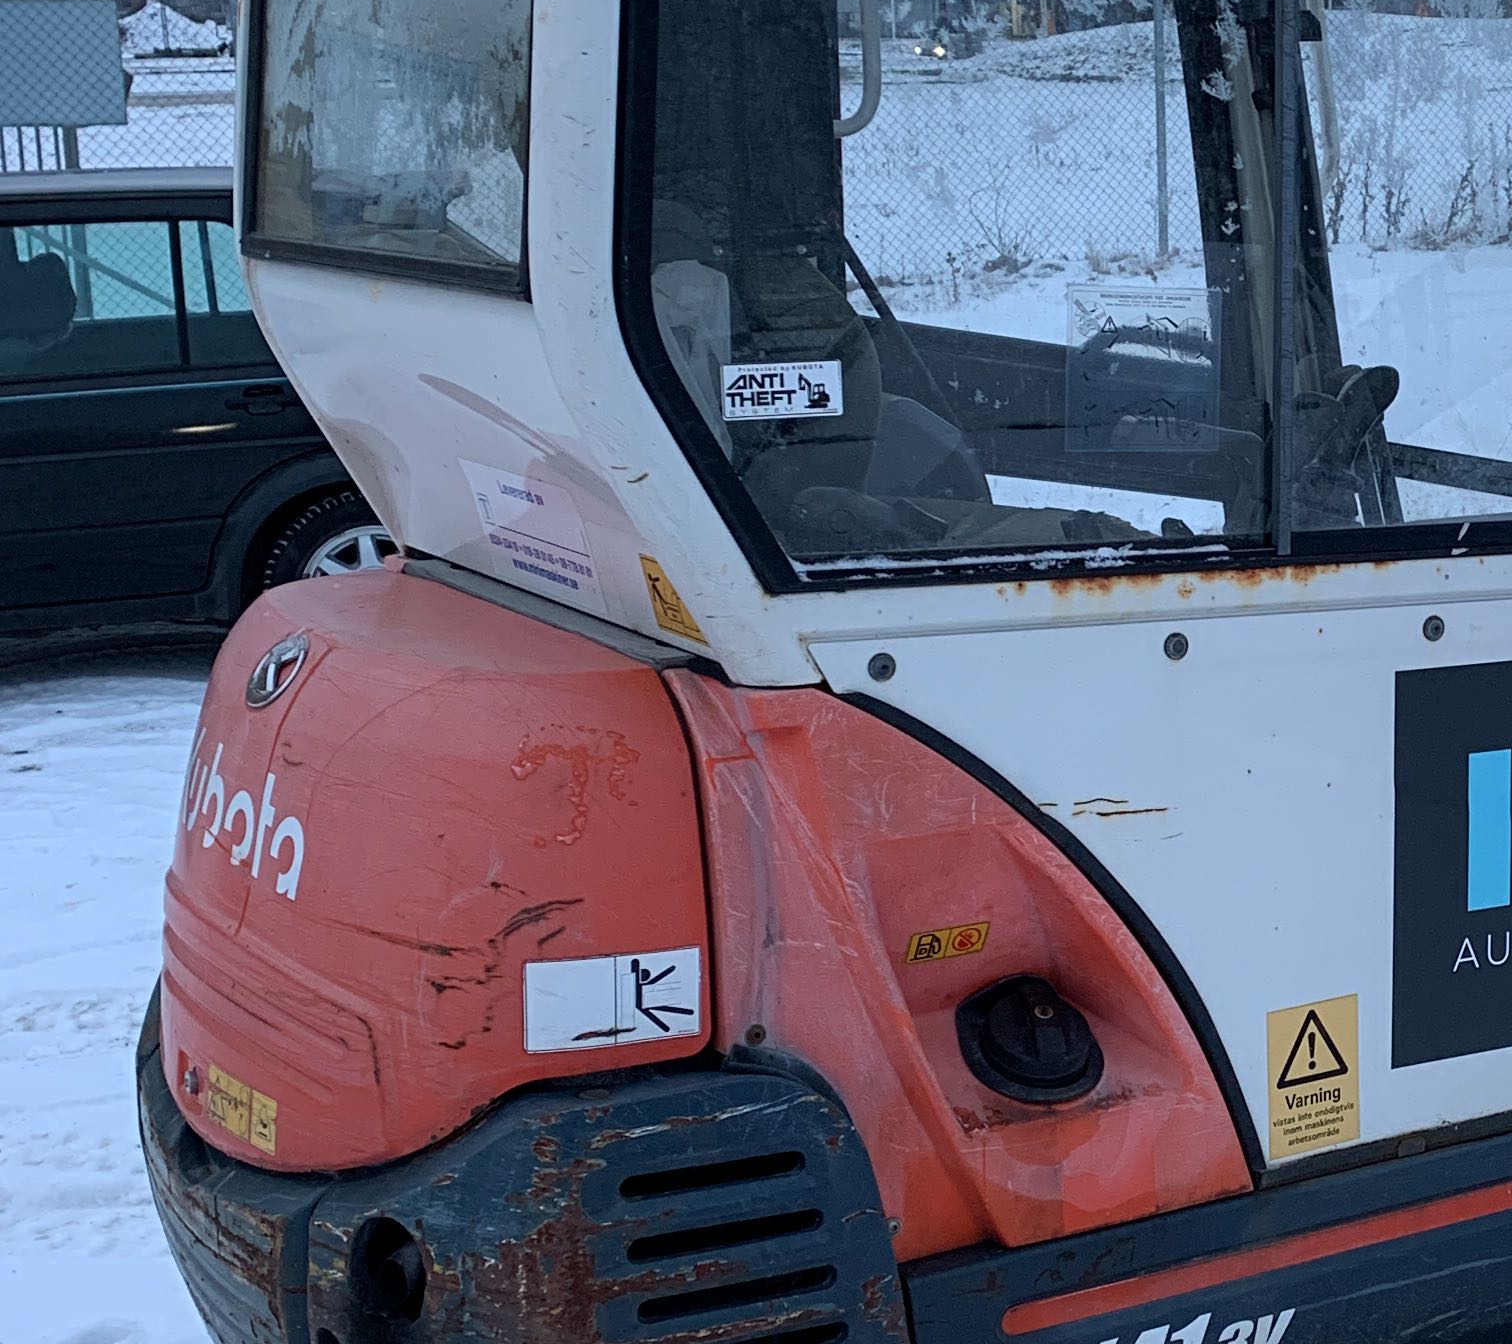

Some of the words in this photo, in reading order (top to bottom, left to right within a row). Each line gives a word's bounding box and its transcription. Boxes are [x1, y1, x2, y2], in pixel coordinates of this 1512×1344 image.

[726, 373, 785, 390] ANTI
[726, 390, 797, 408] THEFT
[729, 407, 793, 416] SYSTEM
[1285, 1087, 1341, 1110] Varning
[1272, 1116, 1296, 1127] vistas
[1298, 1112, 1313, 1122] inte
[1283, 1125, 1302, 1136] inom
[1304, 1116, 1345, 1131] maskinens
[1288, 1127, 1340, 1146] arbetsområde
